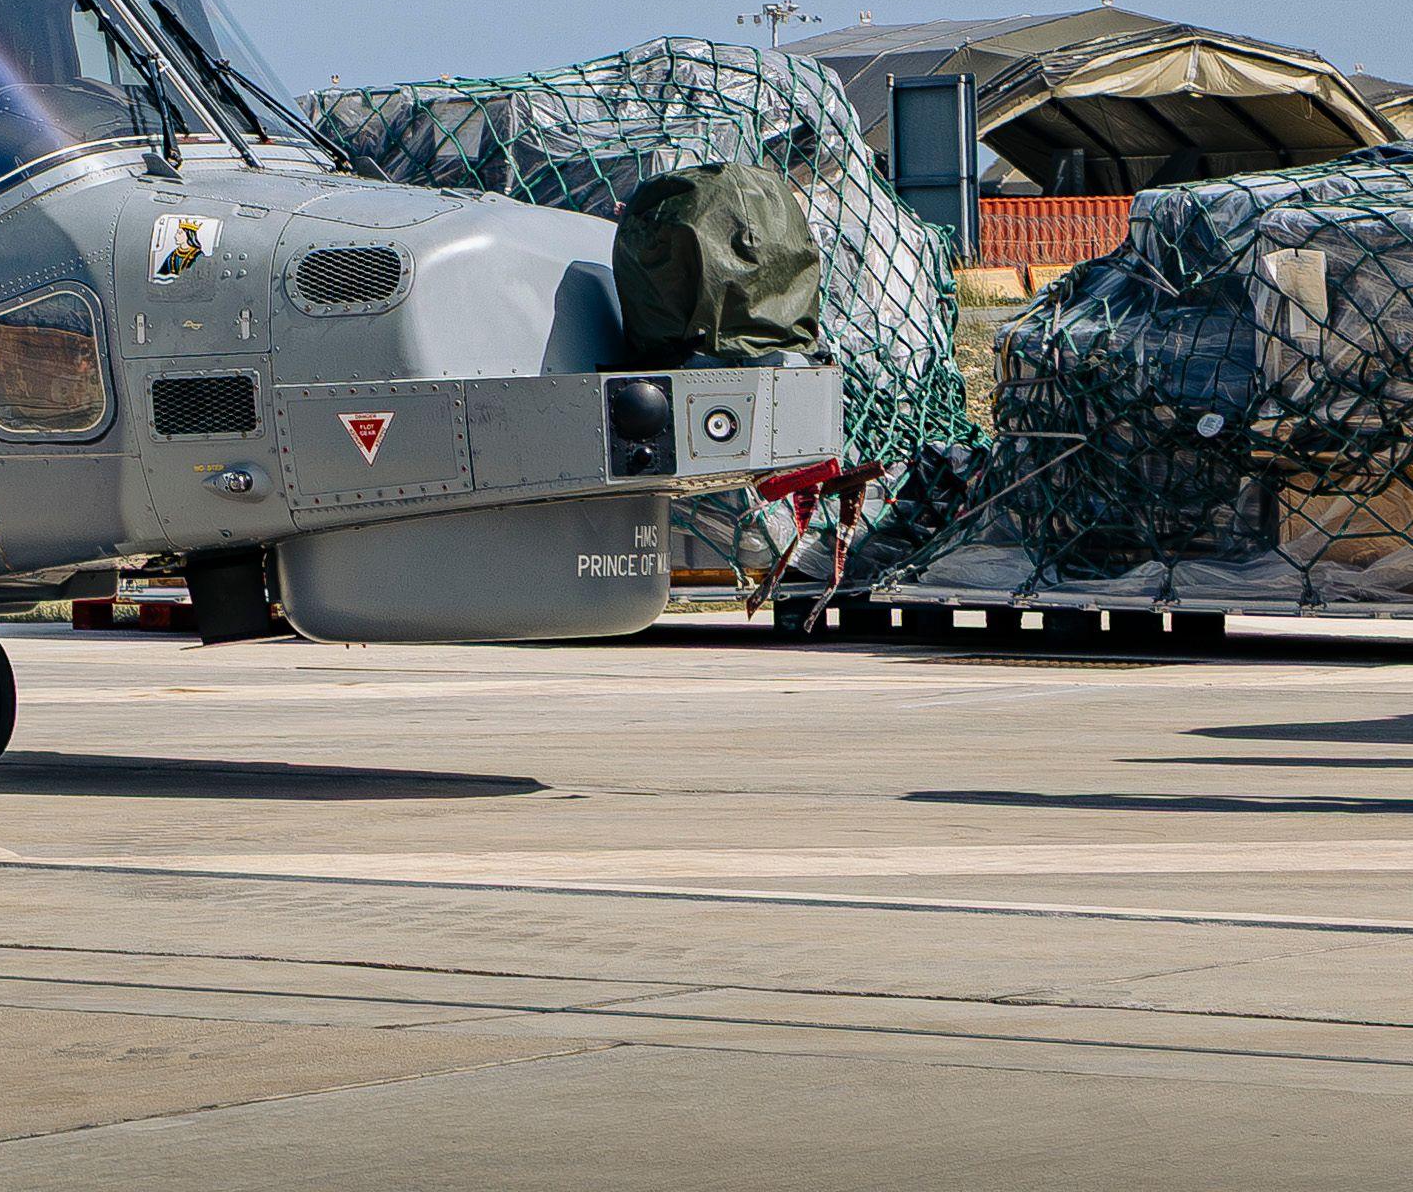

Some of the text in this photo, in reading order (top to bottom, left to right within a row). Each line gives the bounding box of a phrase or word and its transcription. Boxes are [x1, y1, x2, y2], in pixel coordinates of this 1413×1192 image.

[634, 525, 658, 548] HMS
[577, 554, 638, 578] PRINCE
[640, 553, 657, 577] OF
